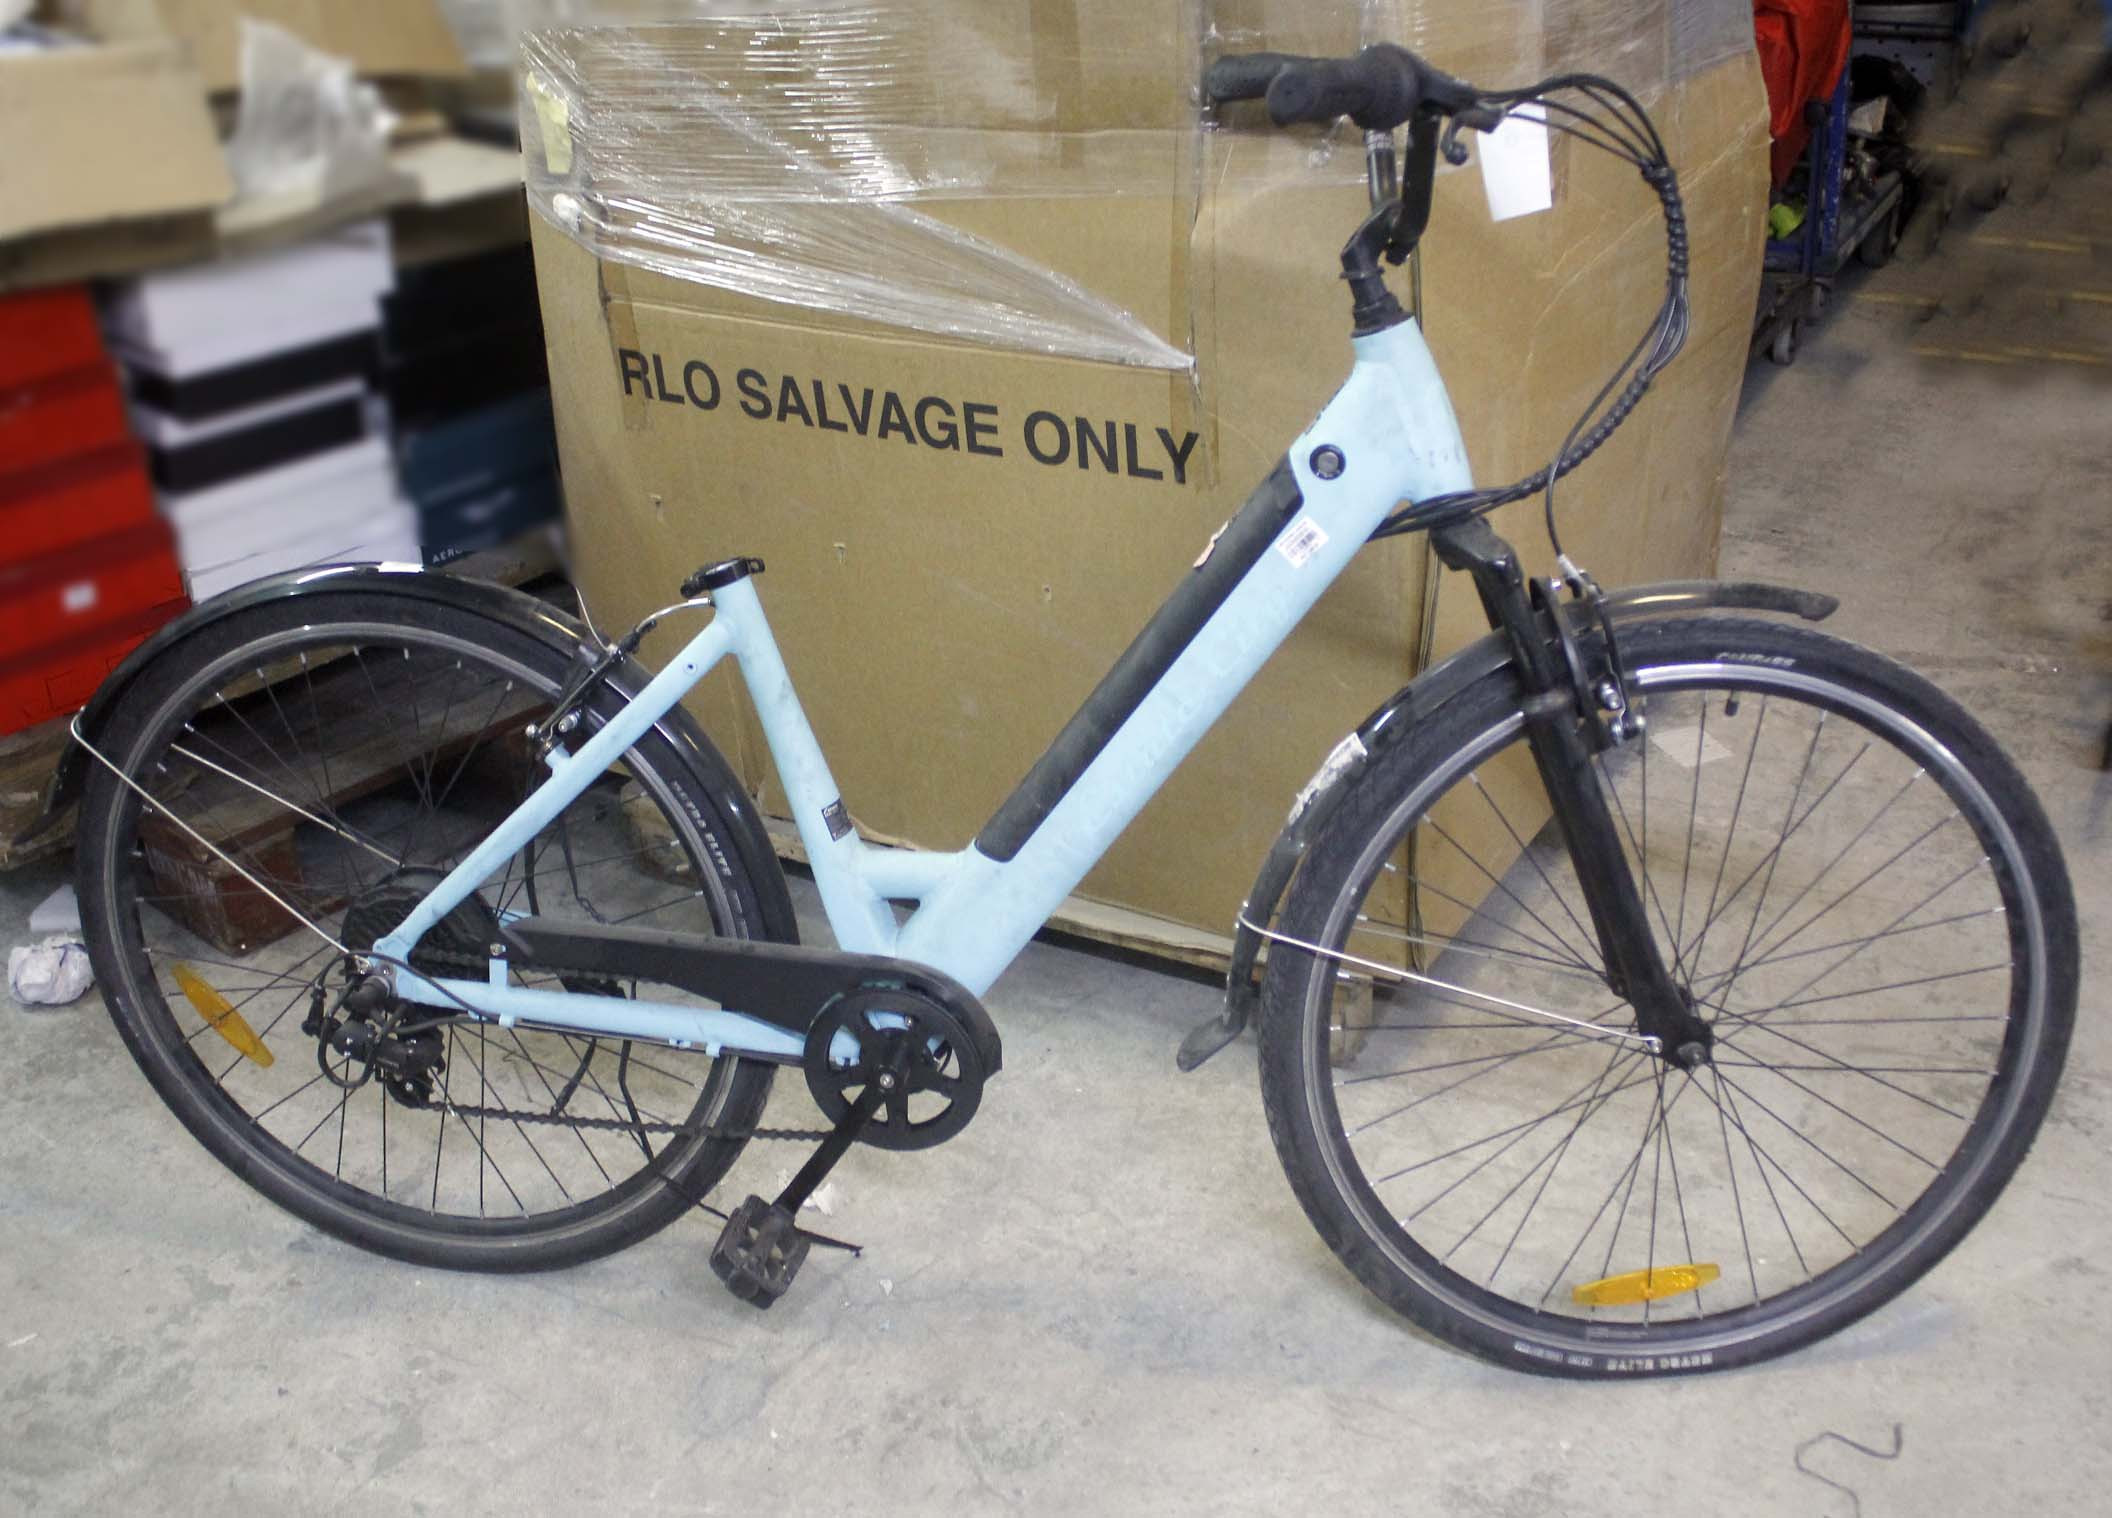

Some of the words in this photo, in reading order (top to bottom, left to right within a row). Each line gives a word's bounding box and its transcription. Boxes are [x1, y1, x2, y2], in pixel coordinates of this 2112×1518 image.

[618, 347, 721, 411] RLO
[736, 368, 1003, 457] SALVAGE
[1023, 411, 1199, 485] ONLY
